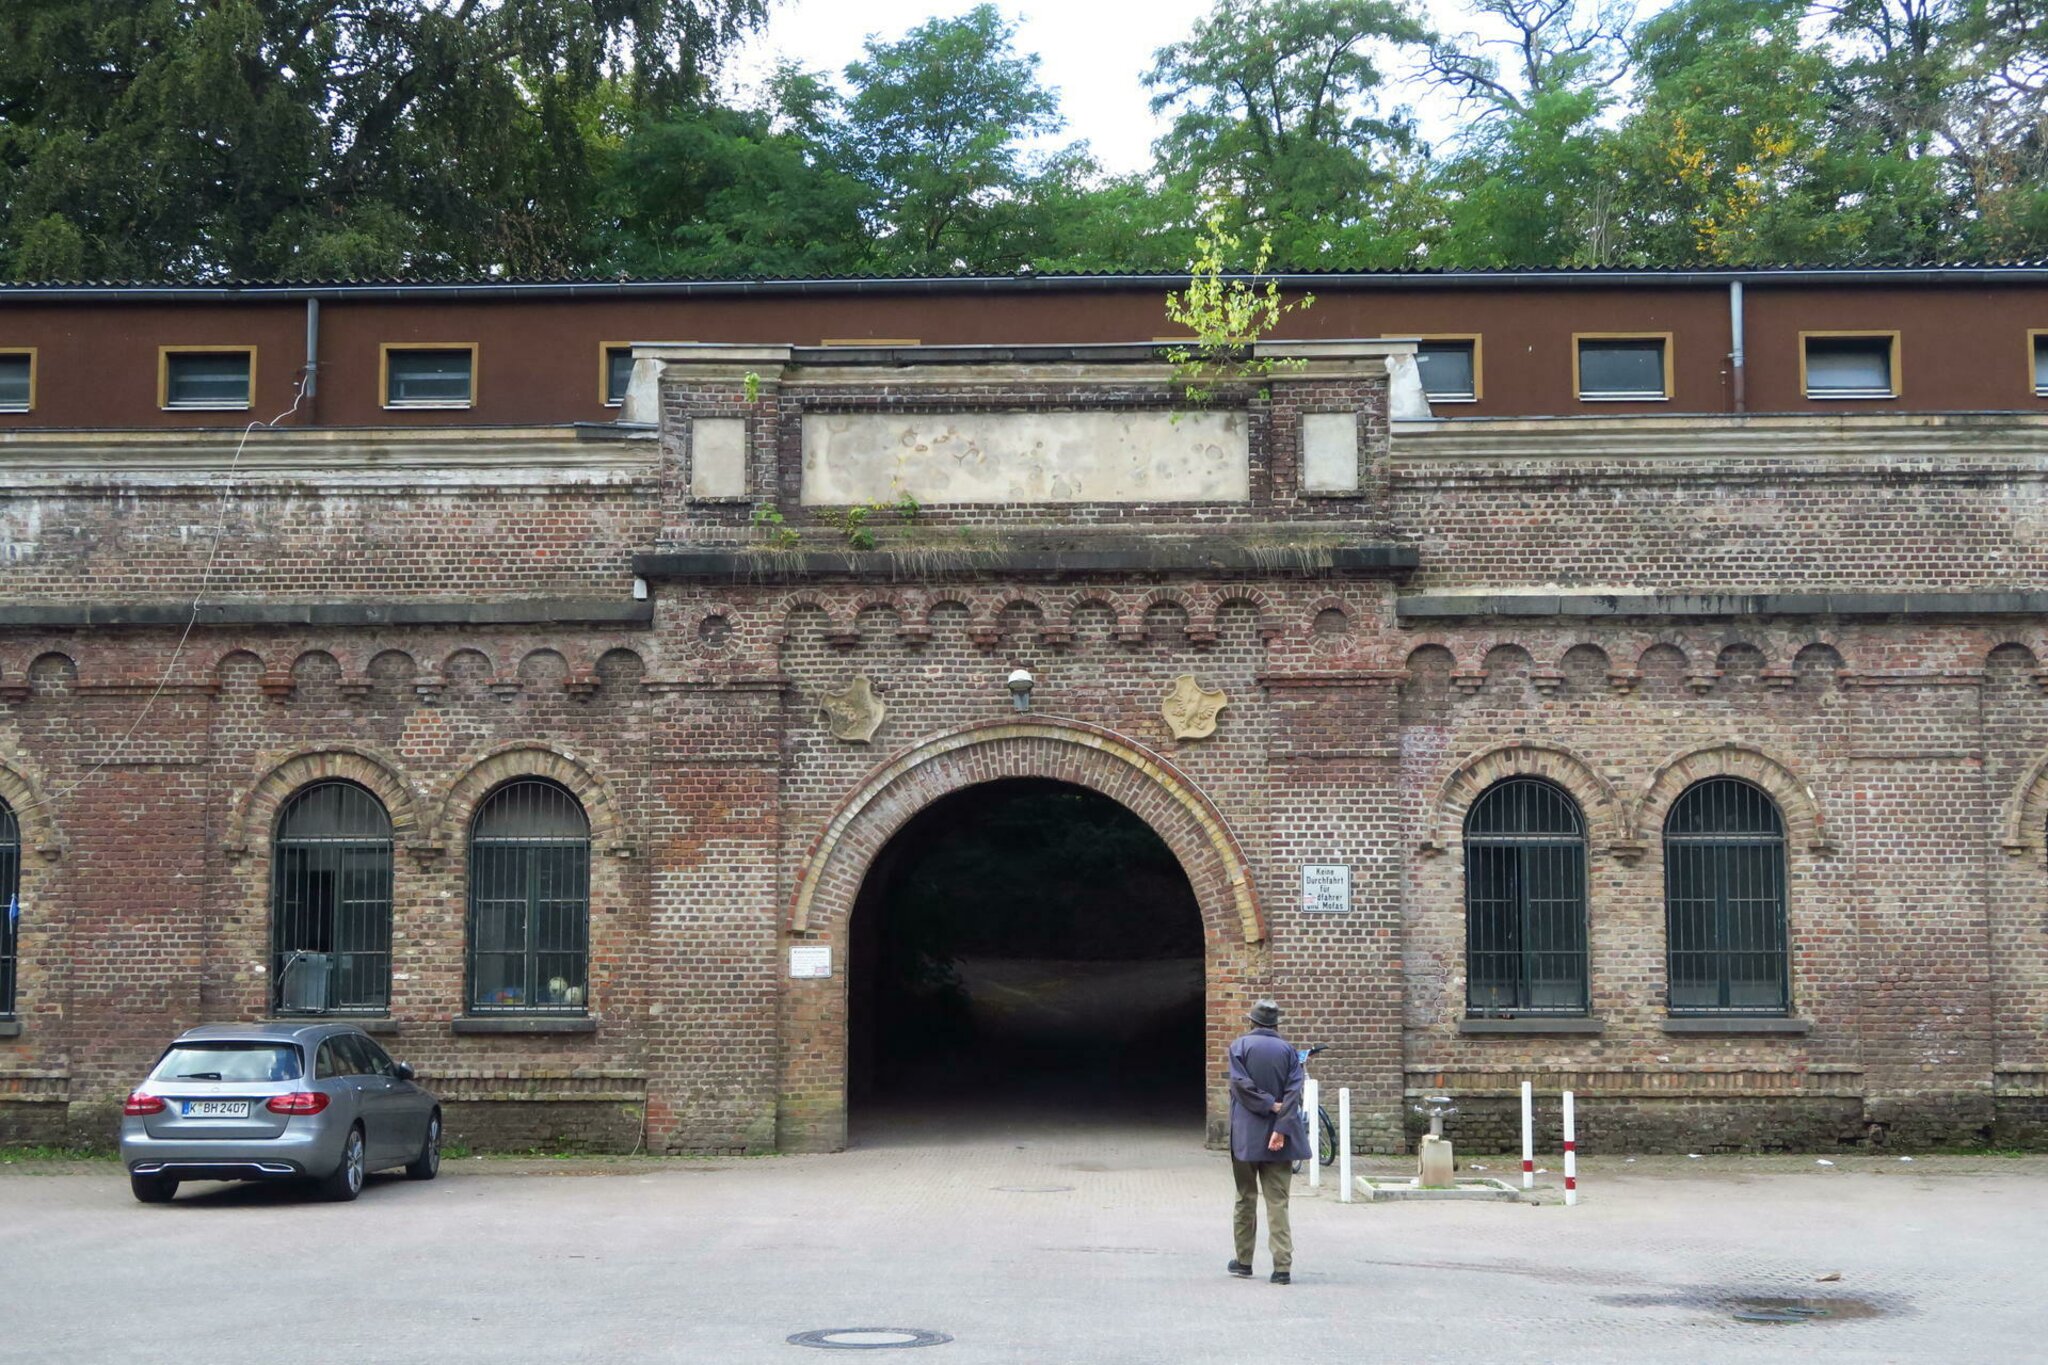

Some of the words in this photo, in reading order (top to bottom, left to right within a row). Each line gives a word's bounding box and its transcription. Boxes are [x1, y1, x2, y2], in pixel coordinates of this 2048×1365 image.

[1306, 876, 1344, 884] Durchfahrt
[1320, 885, 1330, 893] für
[190, 1103, 197, 1113] K
[204, 1103, 218, 1113] BH
[220, 1103, 247, 1113] 2407
